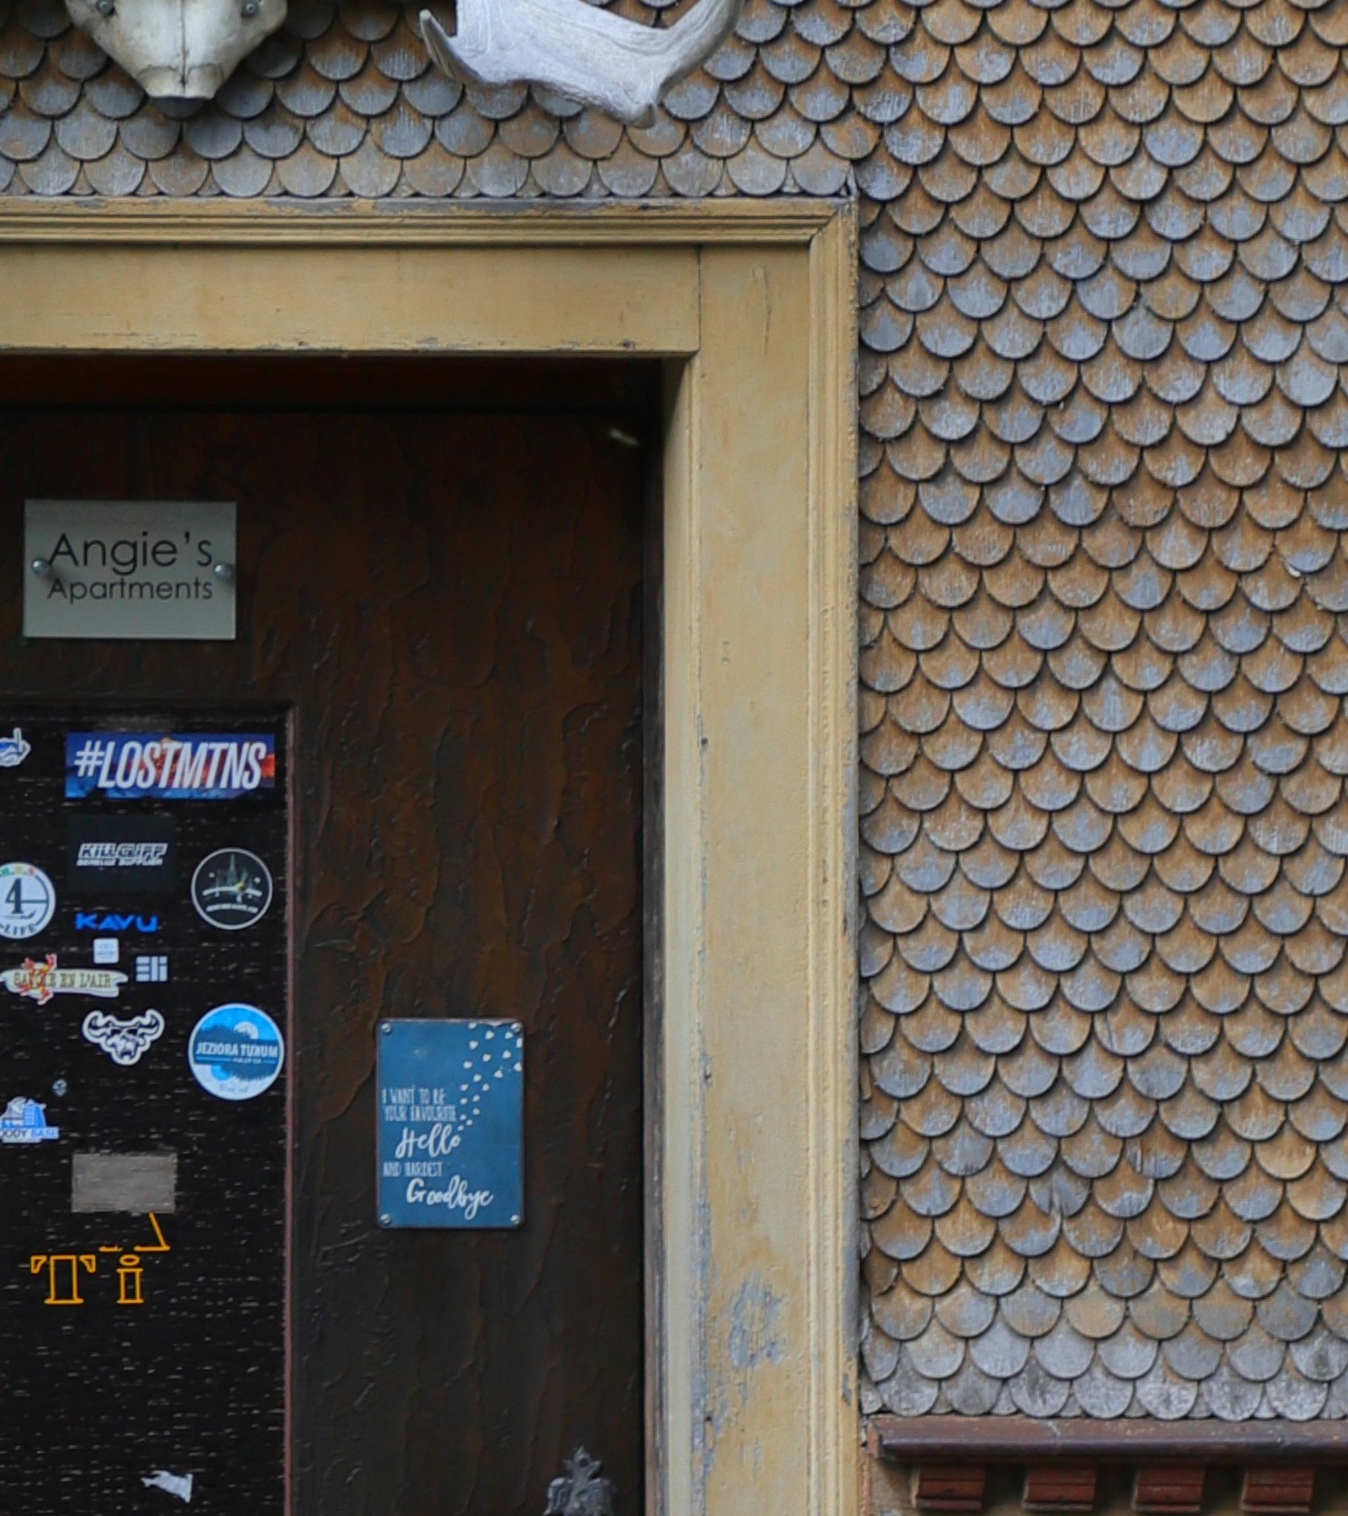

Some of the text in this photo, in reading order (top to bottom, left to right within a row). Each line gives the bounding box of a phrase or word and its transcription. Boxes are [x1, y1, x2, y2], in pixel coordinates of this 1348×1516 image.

[48, 531, 212, 576] Angie's
[48, 577, 213, 604] Apartments
[74, 740, 266, 789] #LOSTMTNS
[4, 922, 38, 936] LIFE
[75, 913, 159, 933] KAVU
[389, 1085, 416, 1104] WANT
[419, 1088, 431, 1104] TO
[433, 1088, 447, 1104] BE
[385, 1105, 457, 1122] YOUR FAVOURITE
[395, 1122, 461, 1159] Hello
[383, 1162, 442, 1177] AND HARDEST
[406, 1174, 494, 1220] Goodbye
